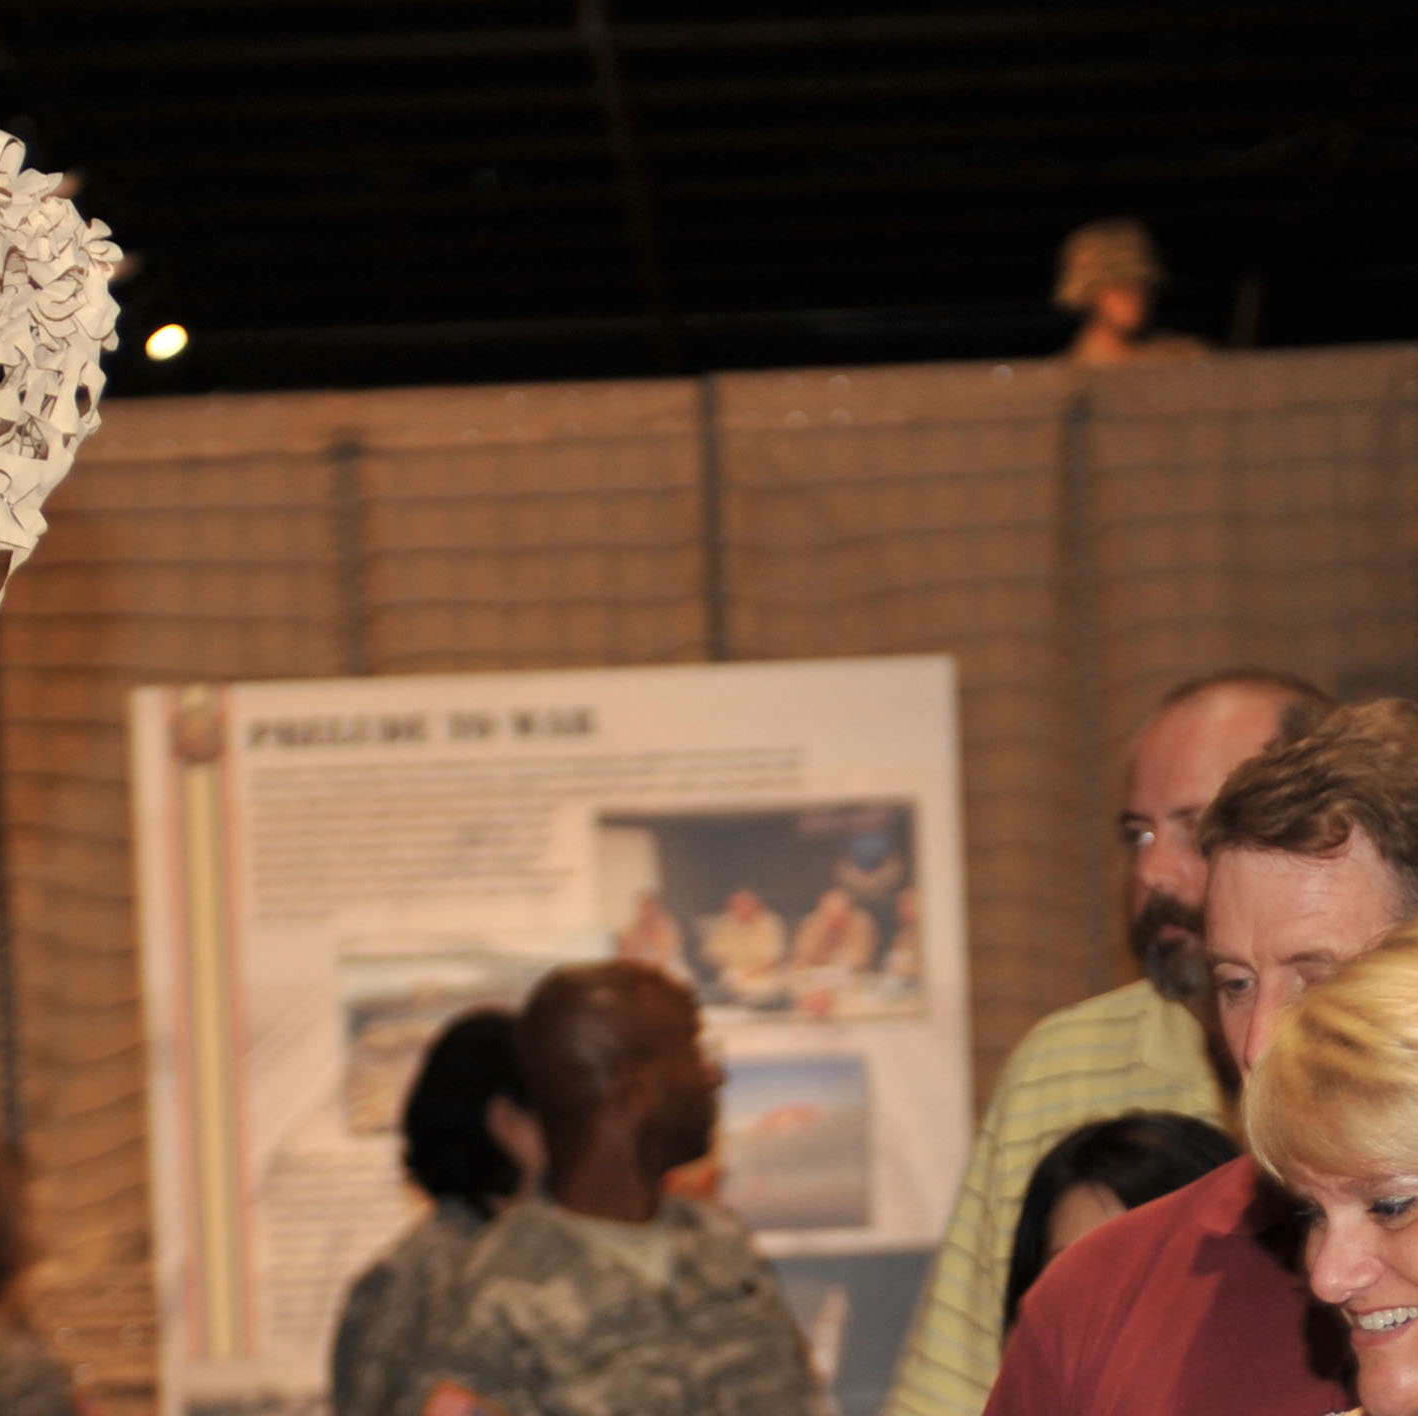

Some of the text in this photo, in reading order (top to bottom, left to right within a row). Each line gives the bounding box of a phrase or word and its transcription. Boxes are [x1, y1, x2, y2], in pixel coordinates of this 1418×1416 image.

[248, 707, 596, 748] PRELUDE TO WAR
